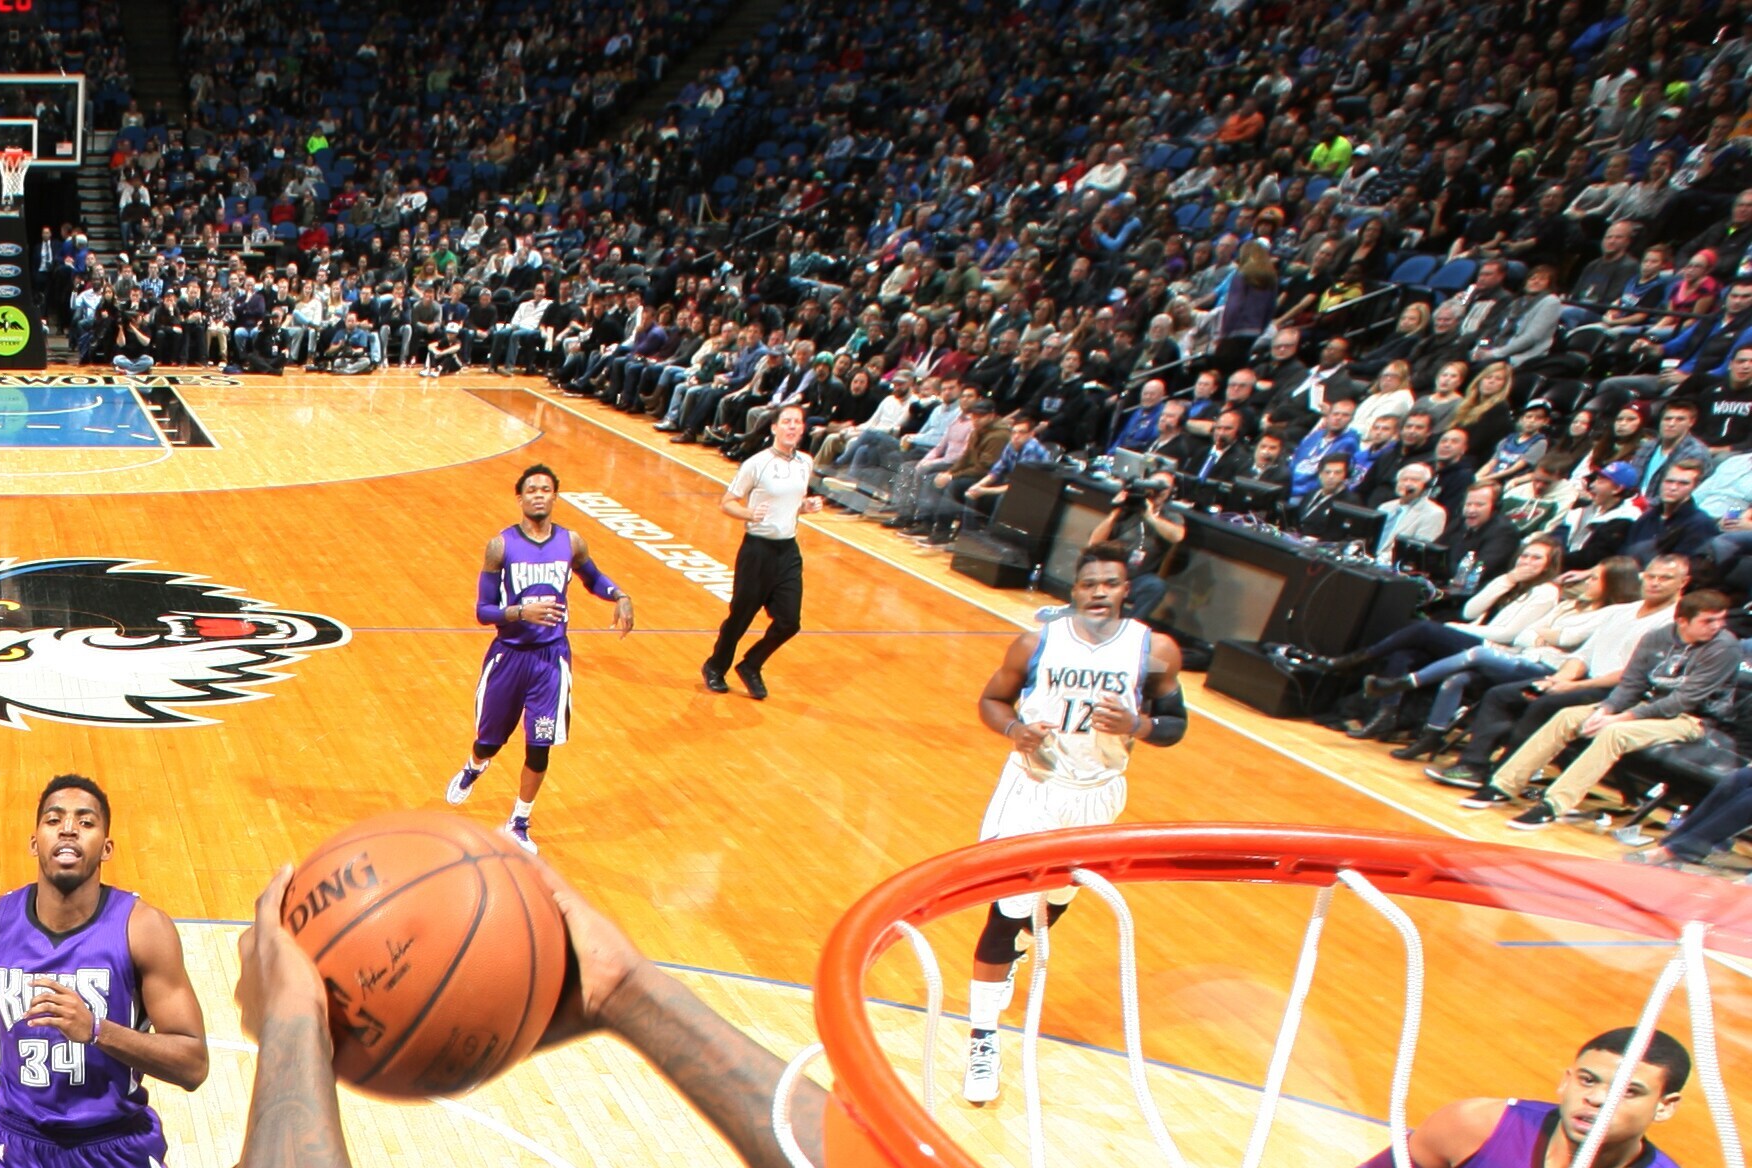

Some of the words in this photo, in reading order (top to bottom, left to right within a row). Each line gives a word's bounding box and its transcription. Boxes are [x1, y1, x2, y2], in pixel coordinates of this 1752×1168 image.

[558, 492, 674, 540] CENTER
[511, 561, 568, 594] KINGS
[634, 541, 734, 603] ARGET
[1047, 667, 1129, 694] WOLVES
[1059, 699, 1094, 733] 12
[287, 853, 378, 936] DING
[19, 1039, 85, 1087] 34
